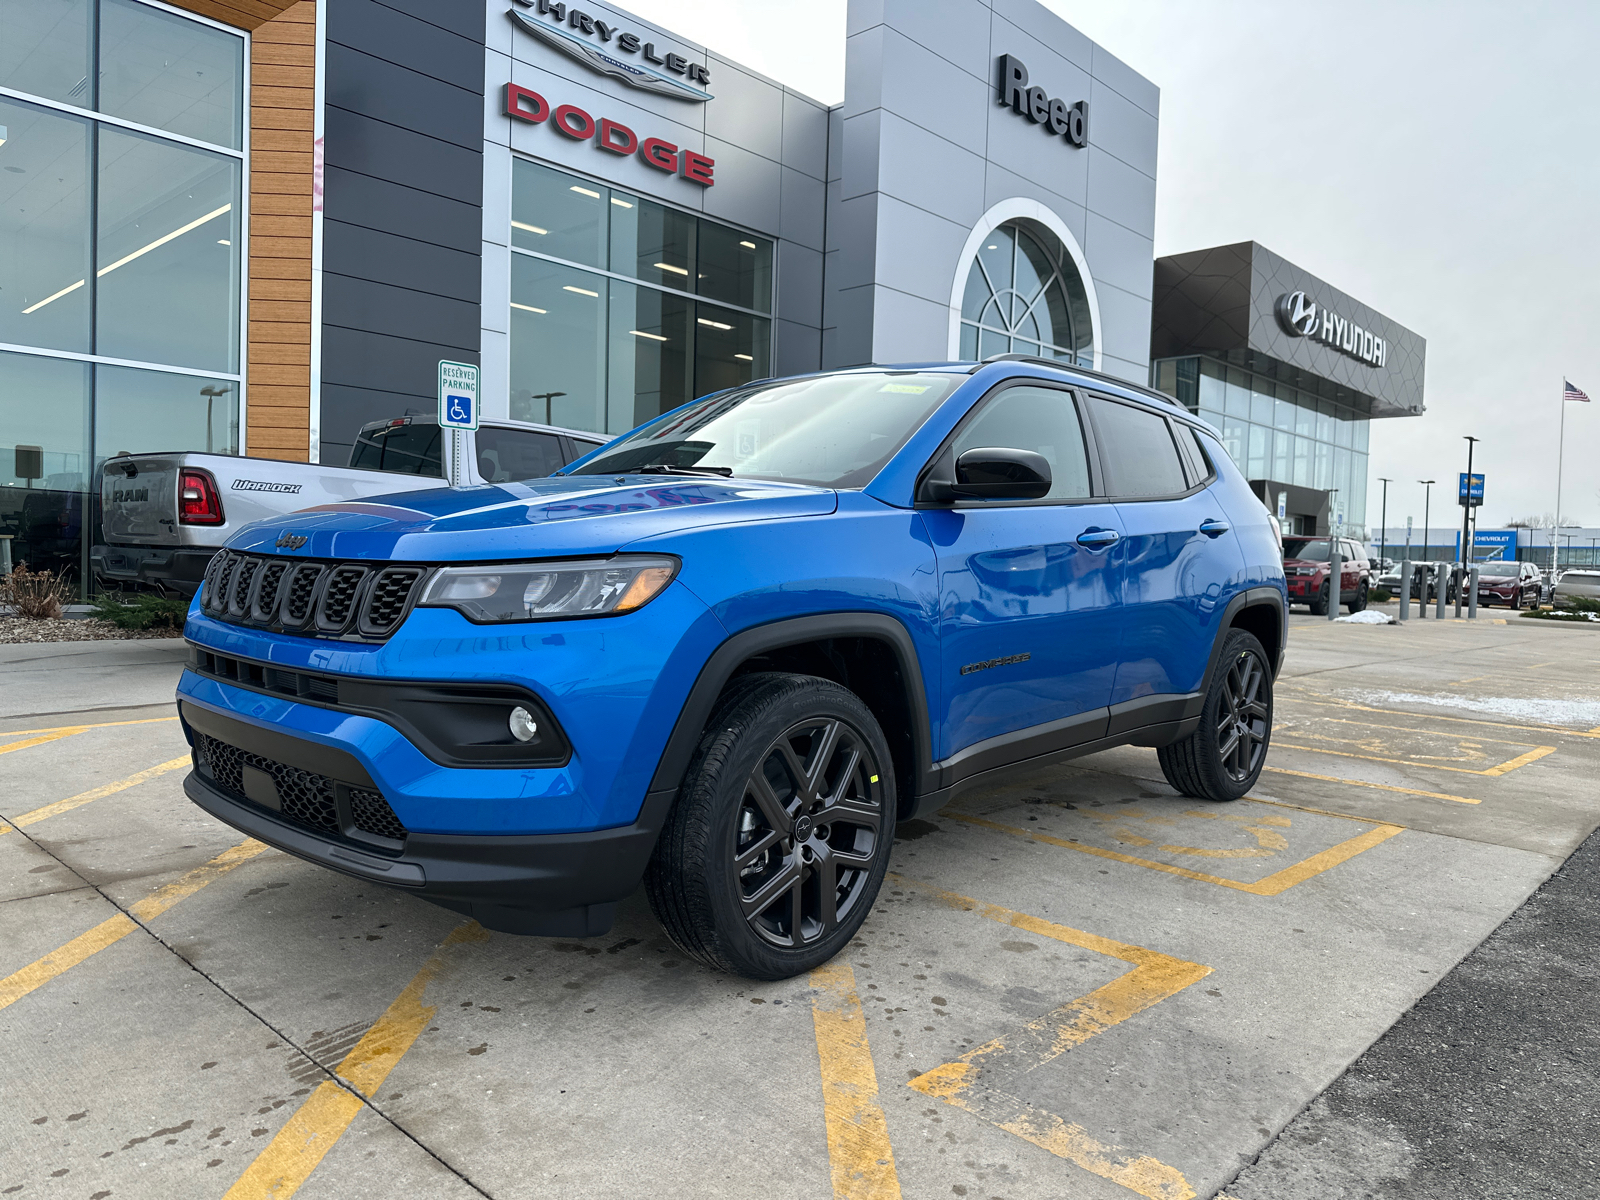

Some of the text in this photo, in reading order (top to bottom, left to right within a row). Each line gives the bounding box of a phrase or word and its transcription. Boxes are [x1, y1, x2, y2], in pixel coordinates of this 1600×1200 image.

[998, 53, 1088, 149] Reed
[502, 82, 715, 187] DODGE
[1320, 308, 1386, 368] HYUNDAI
[443, 367, 475, 381] RESERVED
[443, 379, 475, 392] PARKING
[113, 489, 148, 502] RAM
[231, 479, 302, 494] WARLOCK
[275, 532, 308, 551] Jeep
[960, 652, 1031, 675] COMPASS
